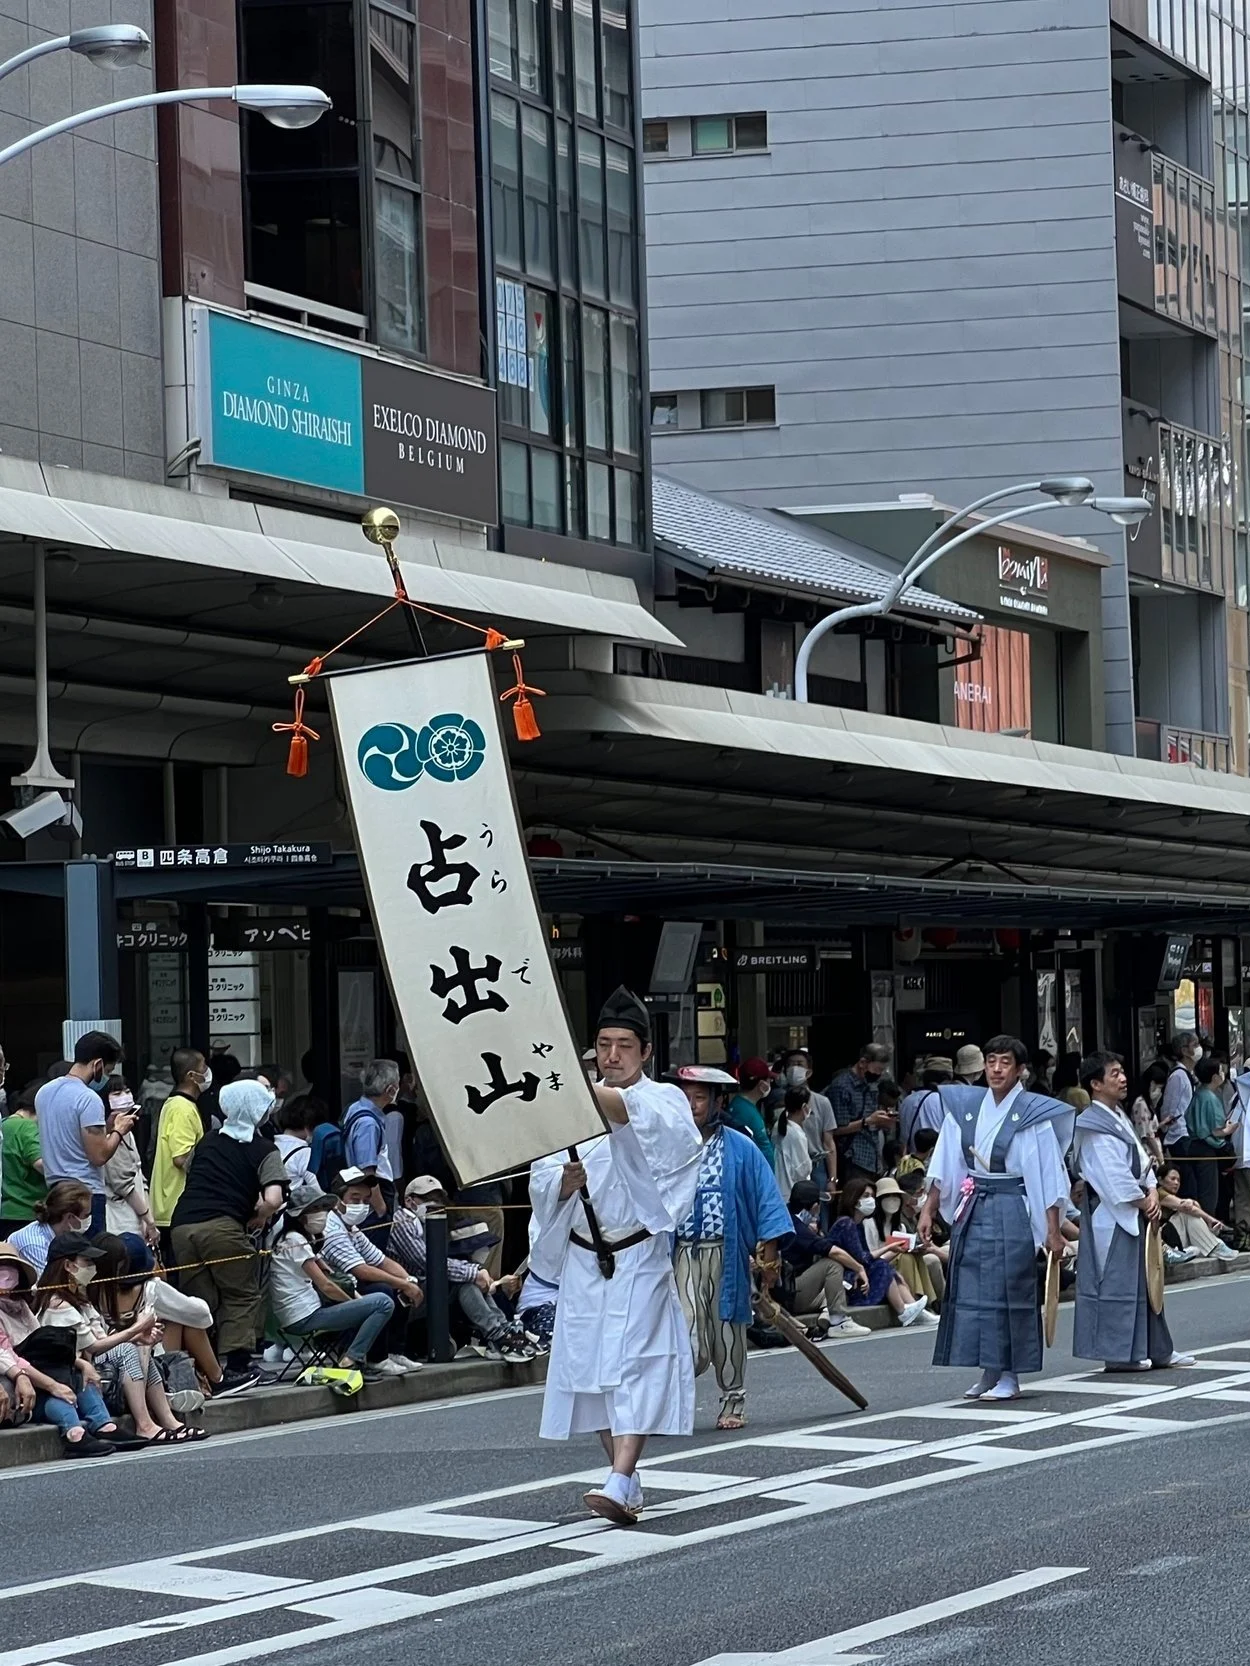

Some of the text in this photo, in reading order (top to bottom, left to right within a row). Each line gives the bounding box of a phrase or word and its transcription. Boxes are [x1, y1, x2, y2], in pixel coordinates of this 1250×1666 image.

[267, 375, 309, 403] GINZA
[223, 391, 352, 446] DIAMOND SHIRAISHI
[373, 404, 486, 454] EXELCO DIAMOND
[398, 442, 464, 474] BELGIUM
[160, 848, 228, 866] 四条高倉
[250, 845, 311, 856] Shijo Takakura
[407, 819, 541, 1115] 占出山
[750, 955, 808, 965] BREITLING
